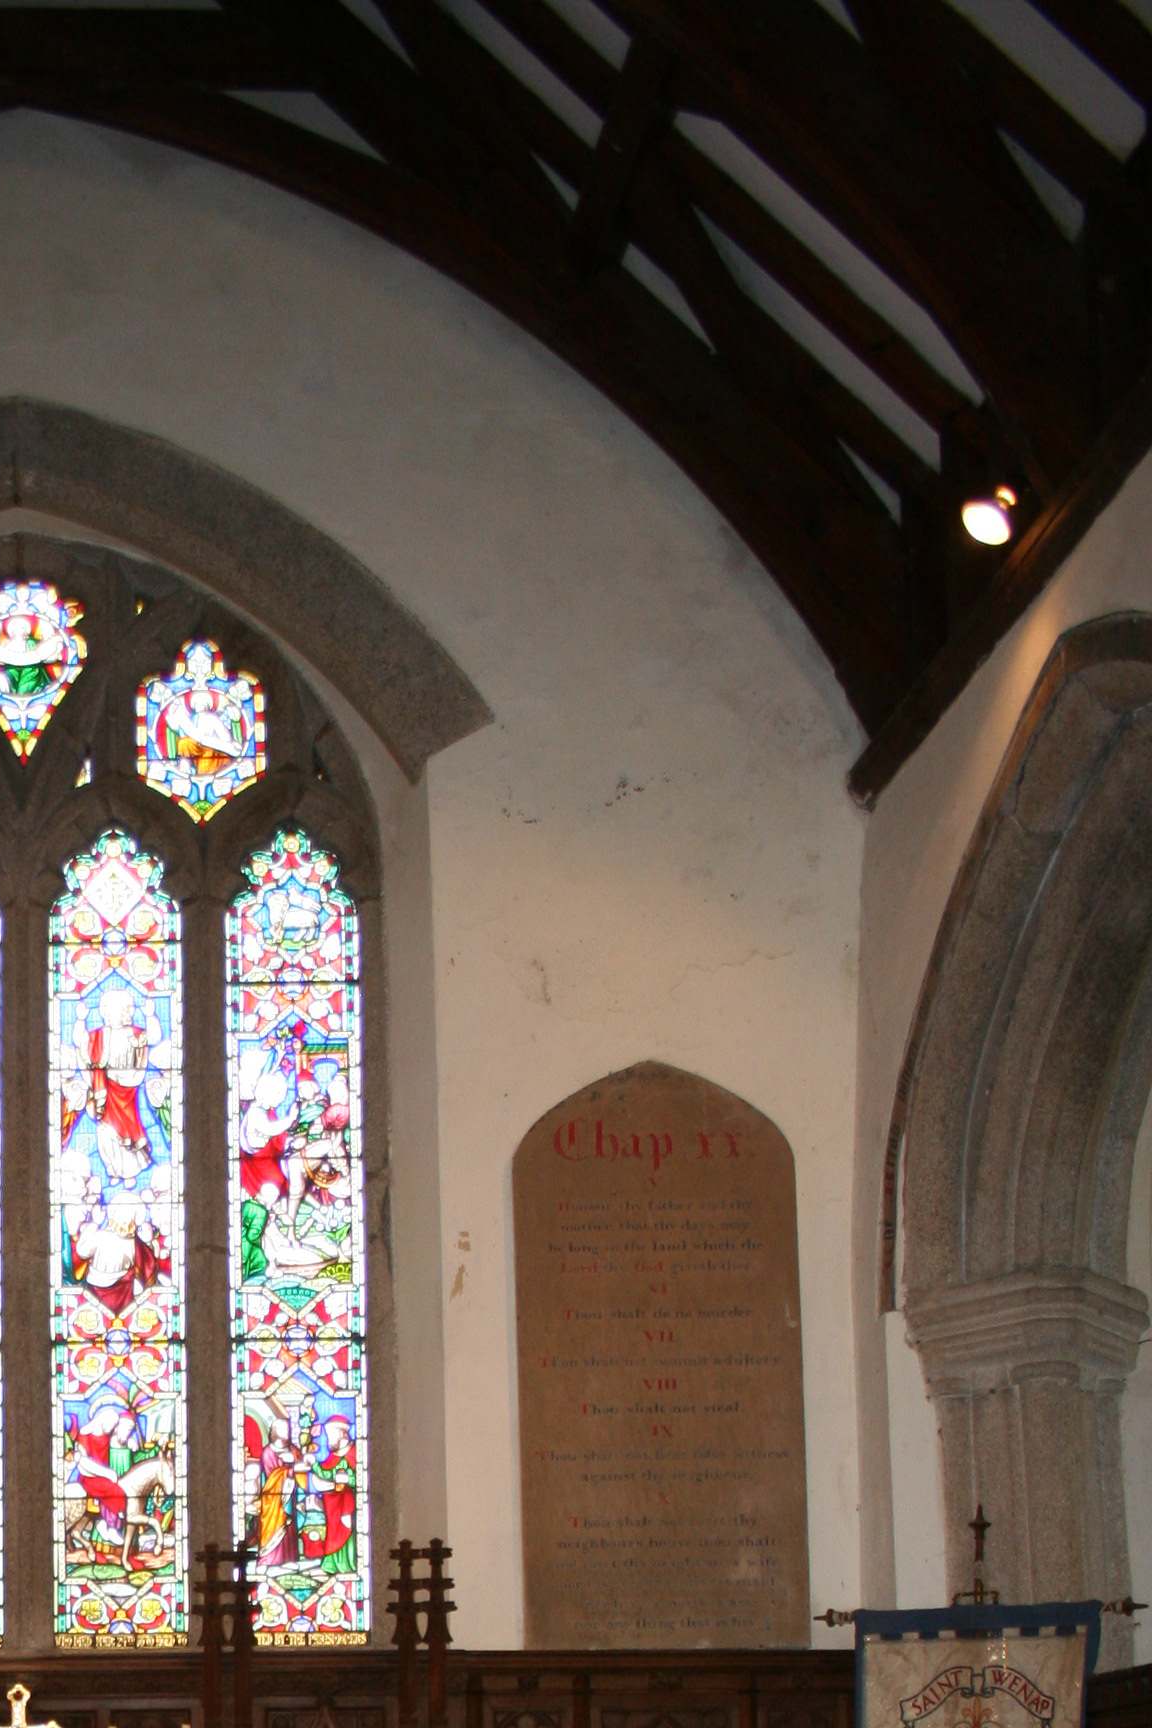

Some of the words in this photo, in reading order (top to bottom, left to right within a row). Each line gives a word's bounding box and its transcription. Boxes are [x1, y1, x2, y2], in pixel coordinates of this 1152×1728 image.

[554, 1119, 673, 1170] Chap
[642, 1330, 676, 1343] VII
[642, 1378, 678, 1391] VIII
[911, 1671, 963, 1716] SAINT
[991, 1670, 1050, 1715] WENAP
